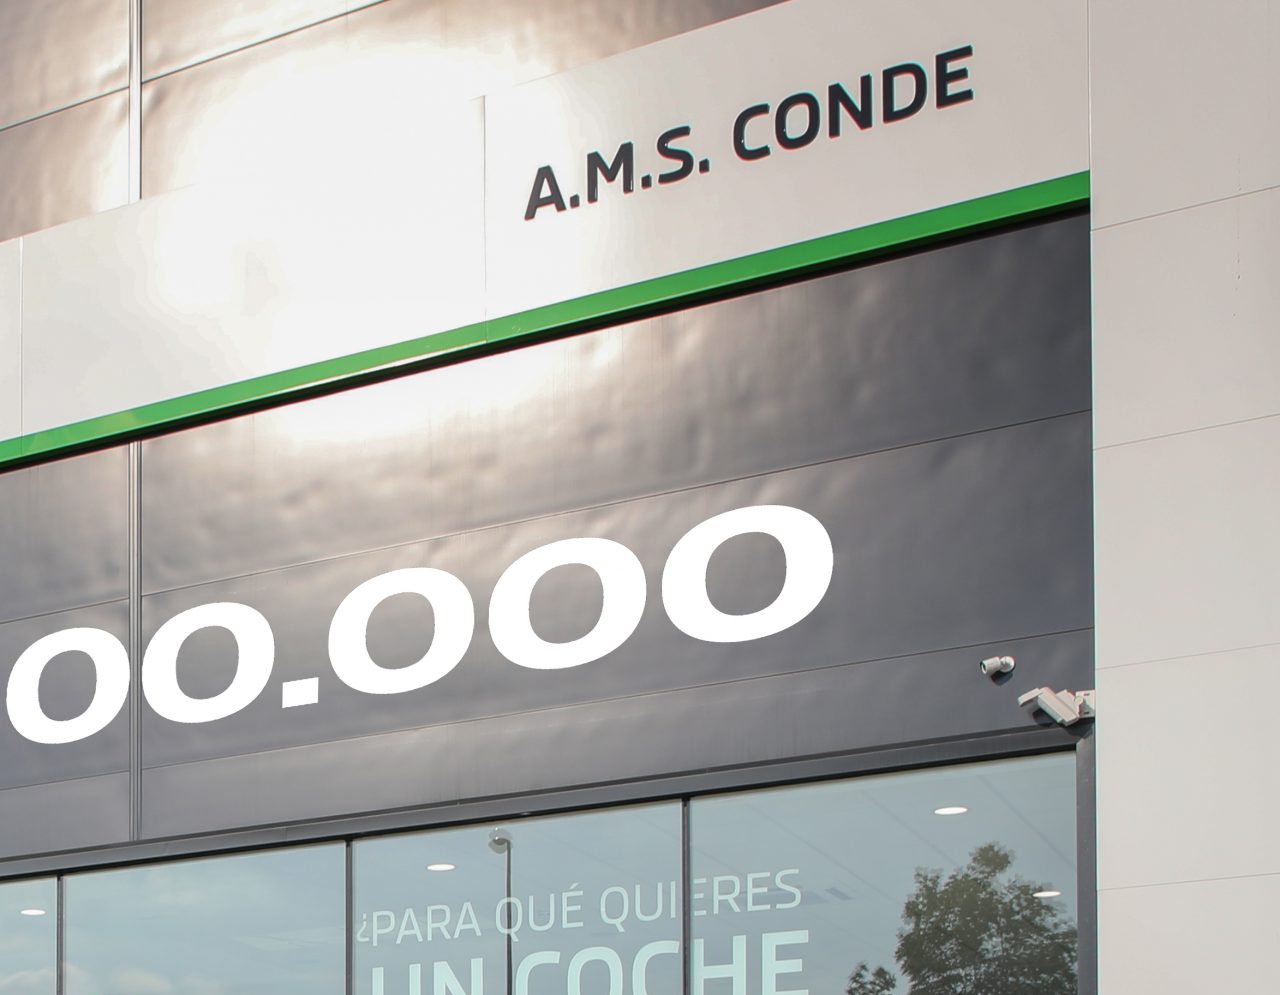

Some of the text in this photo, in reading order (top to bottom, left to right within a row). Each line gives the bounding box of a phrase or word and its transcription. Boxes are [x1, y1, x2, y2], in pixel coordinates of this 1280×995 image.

[524, 44, 975, 220] A.M.S. CONDE
[356, 868, 803, 947] ¿PARA QUÉ QUIERES
